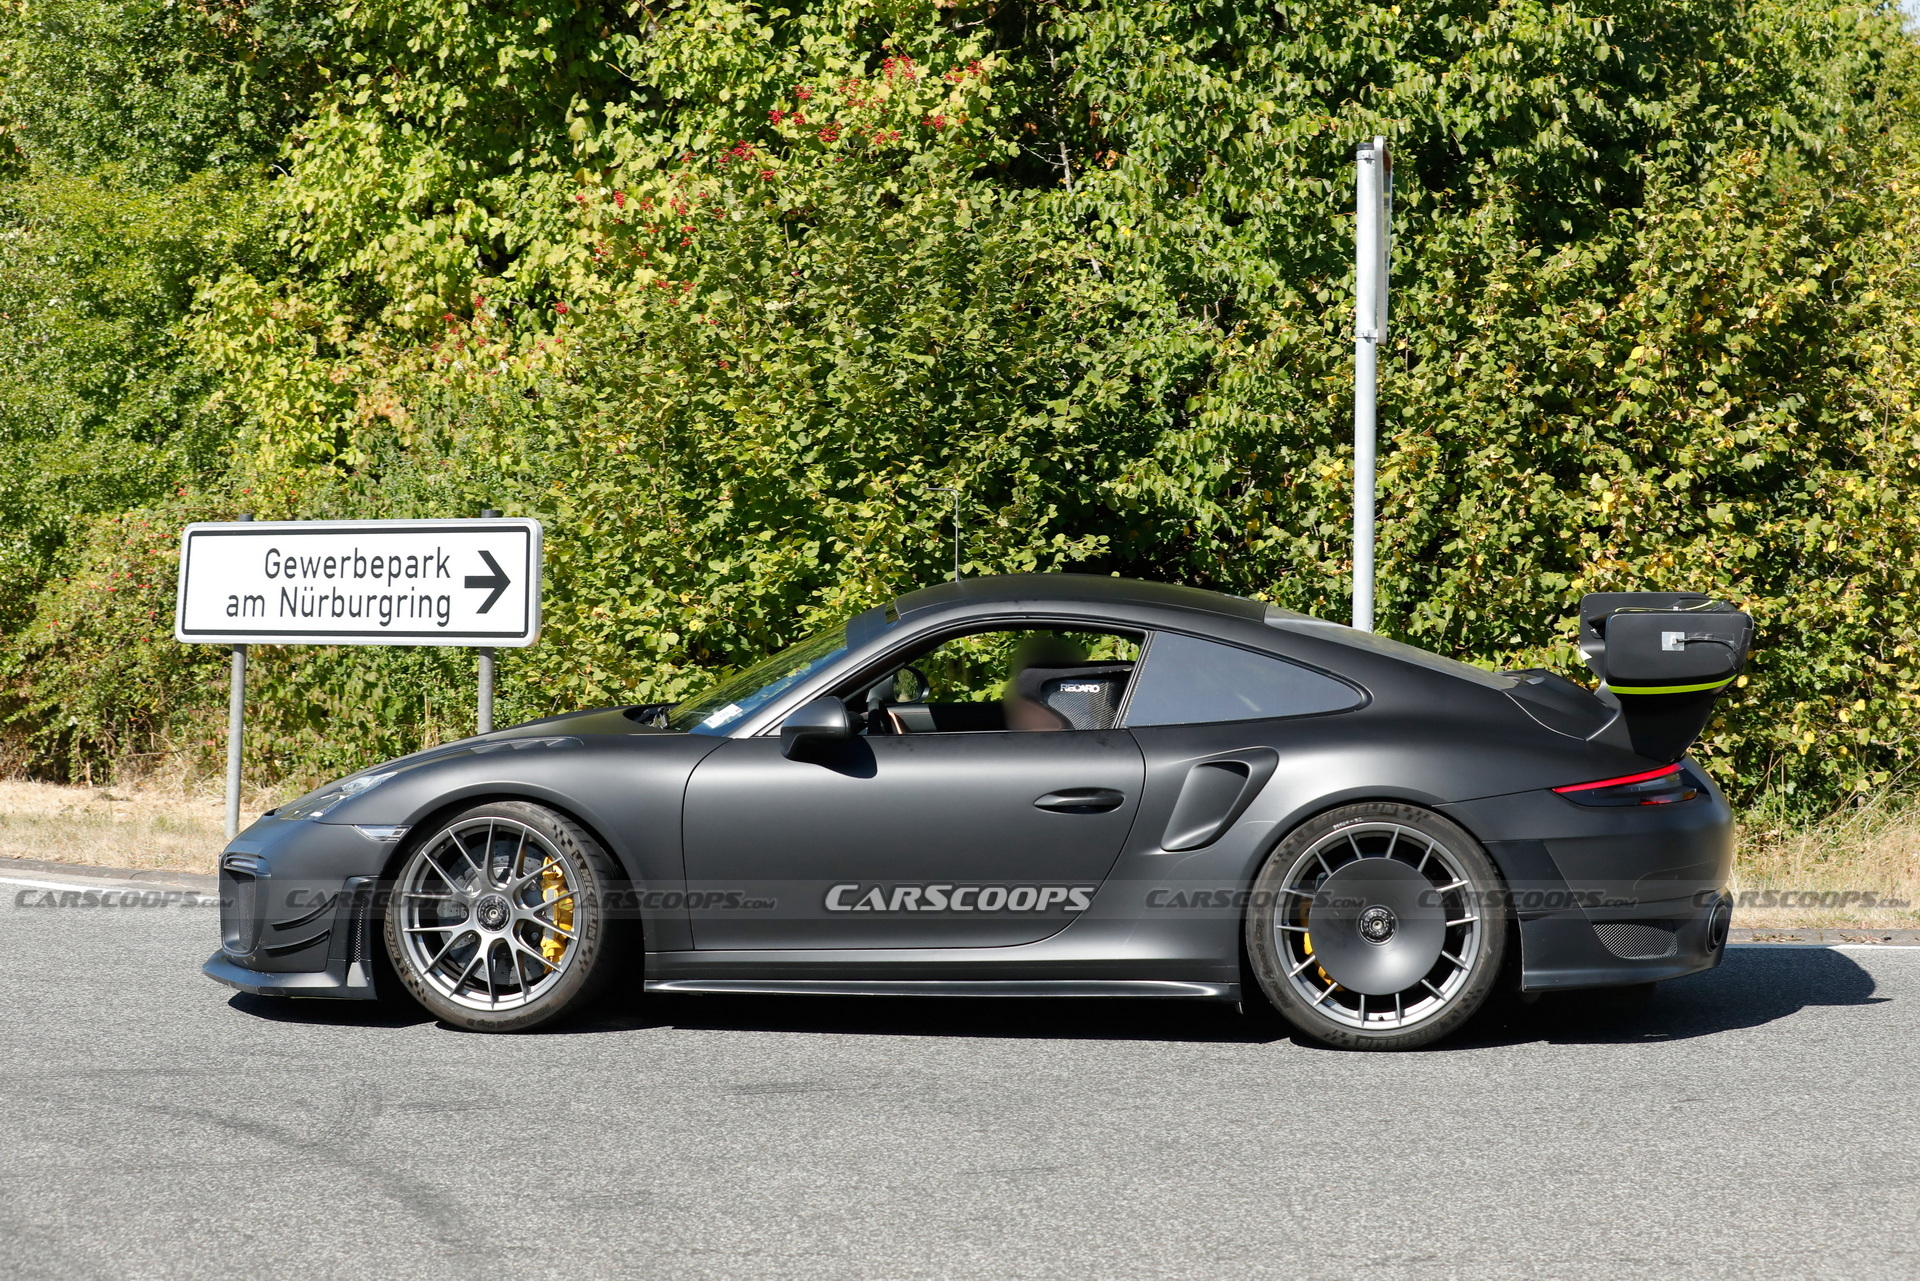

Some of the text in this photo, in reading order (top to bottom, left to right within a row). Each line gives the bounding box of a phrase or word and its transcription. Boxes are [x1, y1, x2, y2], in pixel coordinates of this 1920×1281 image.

[264, 546, 451, 587] Gewerbepark
[226, 586, 451, 627] am Nürburgring
[1060, 683, 1100, 693] RECARO
[1313, 803, 1397, 828] MICHELIN
[580, 868, 598, 939] MICHELIN
